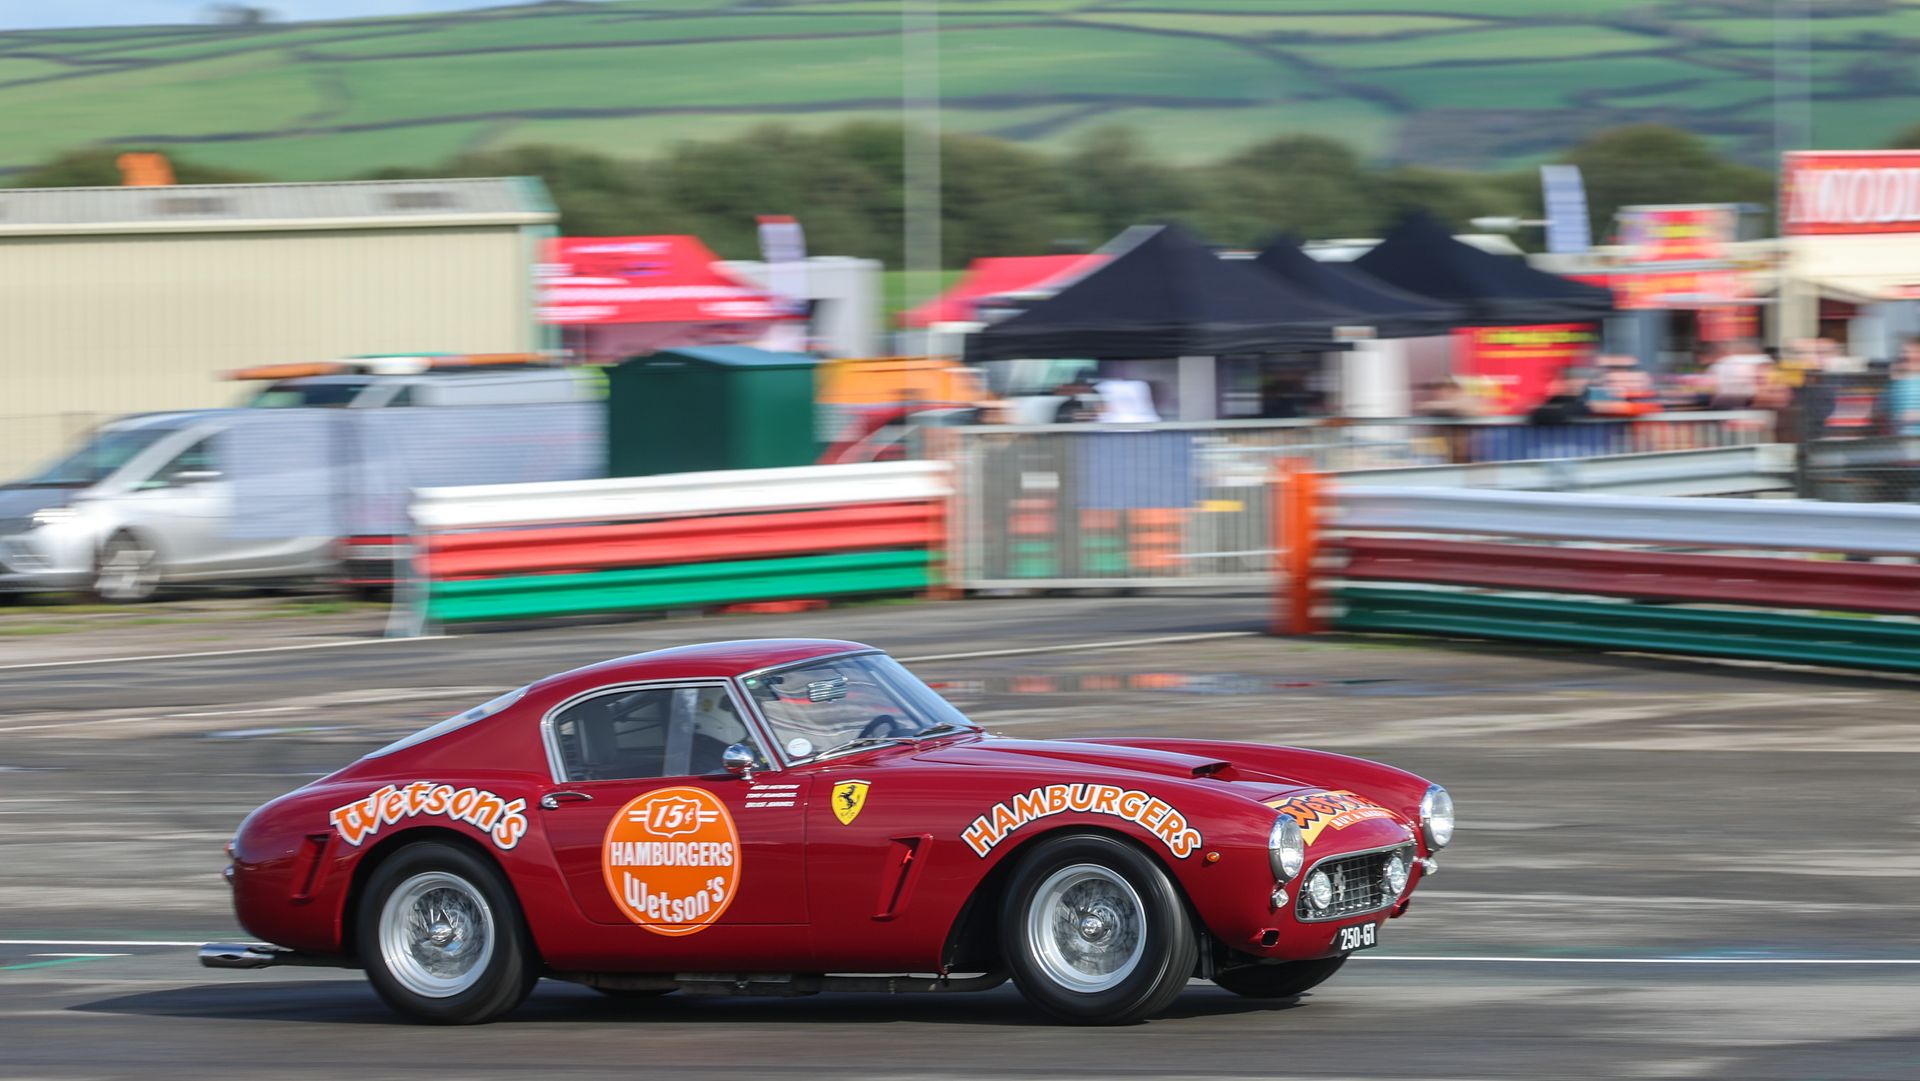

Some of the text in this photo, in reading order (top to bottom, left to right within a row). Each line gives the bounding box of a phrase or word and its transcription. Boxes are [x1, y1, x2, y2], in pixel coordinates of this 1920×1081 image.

[329, 781, 528, 850] Wetson's
[653, 804, 696, 829] 15¢
[960, 783, 1202, 859] HAMBURGERS
[610, 841, 734, 867] HAMBURGERS
[623, 871, 725, 923] Wetson's
